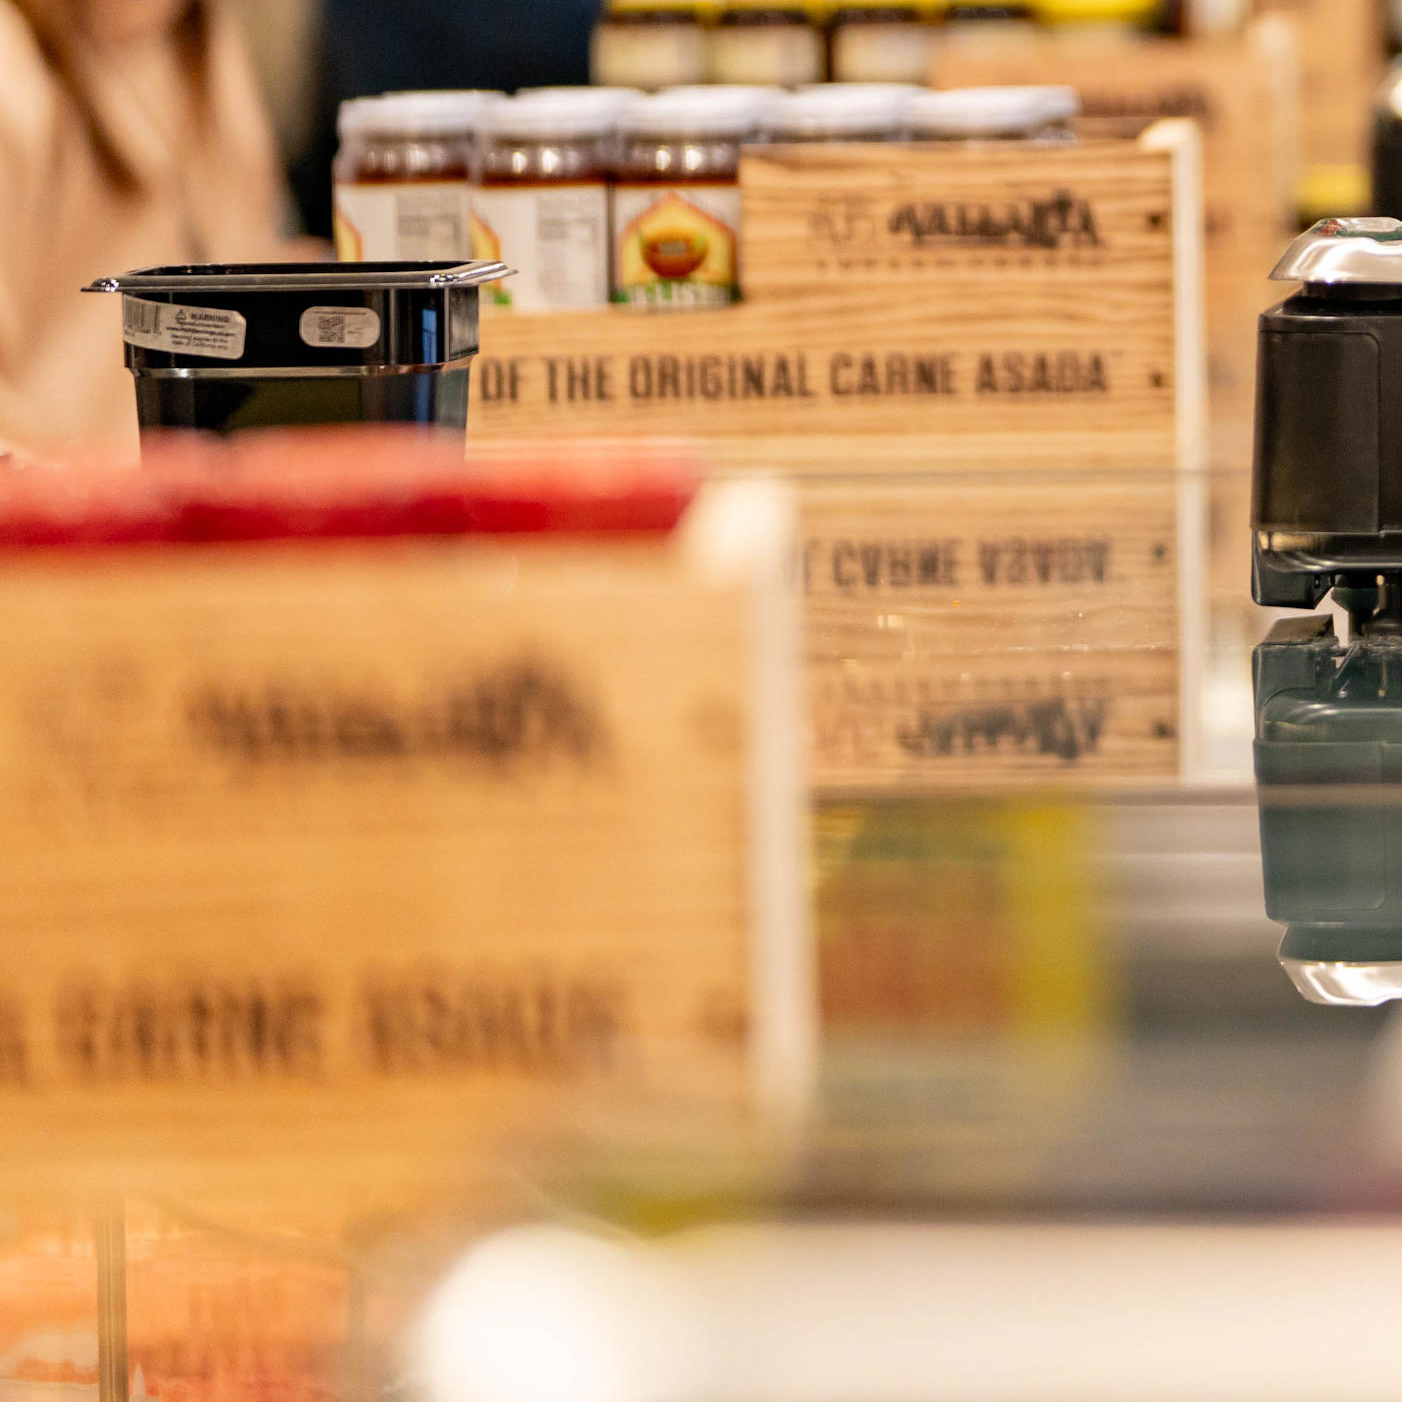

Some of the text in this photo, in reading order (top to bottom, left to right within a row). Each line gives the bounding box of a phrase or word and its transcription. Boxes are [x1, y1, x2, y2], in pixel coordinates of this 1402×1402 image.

[479, 350, 1109, 403] OF THE ORIGINAL CARNE ASADA
